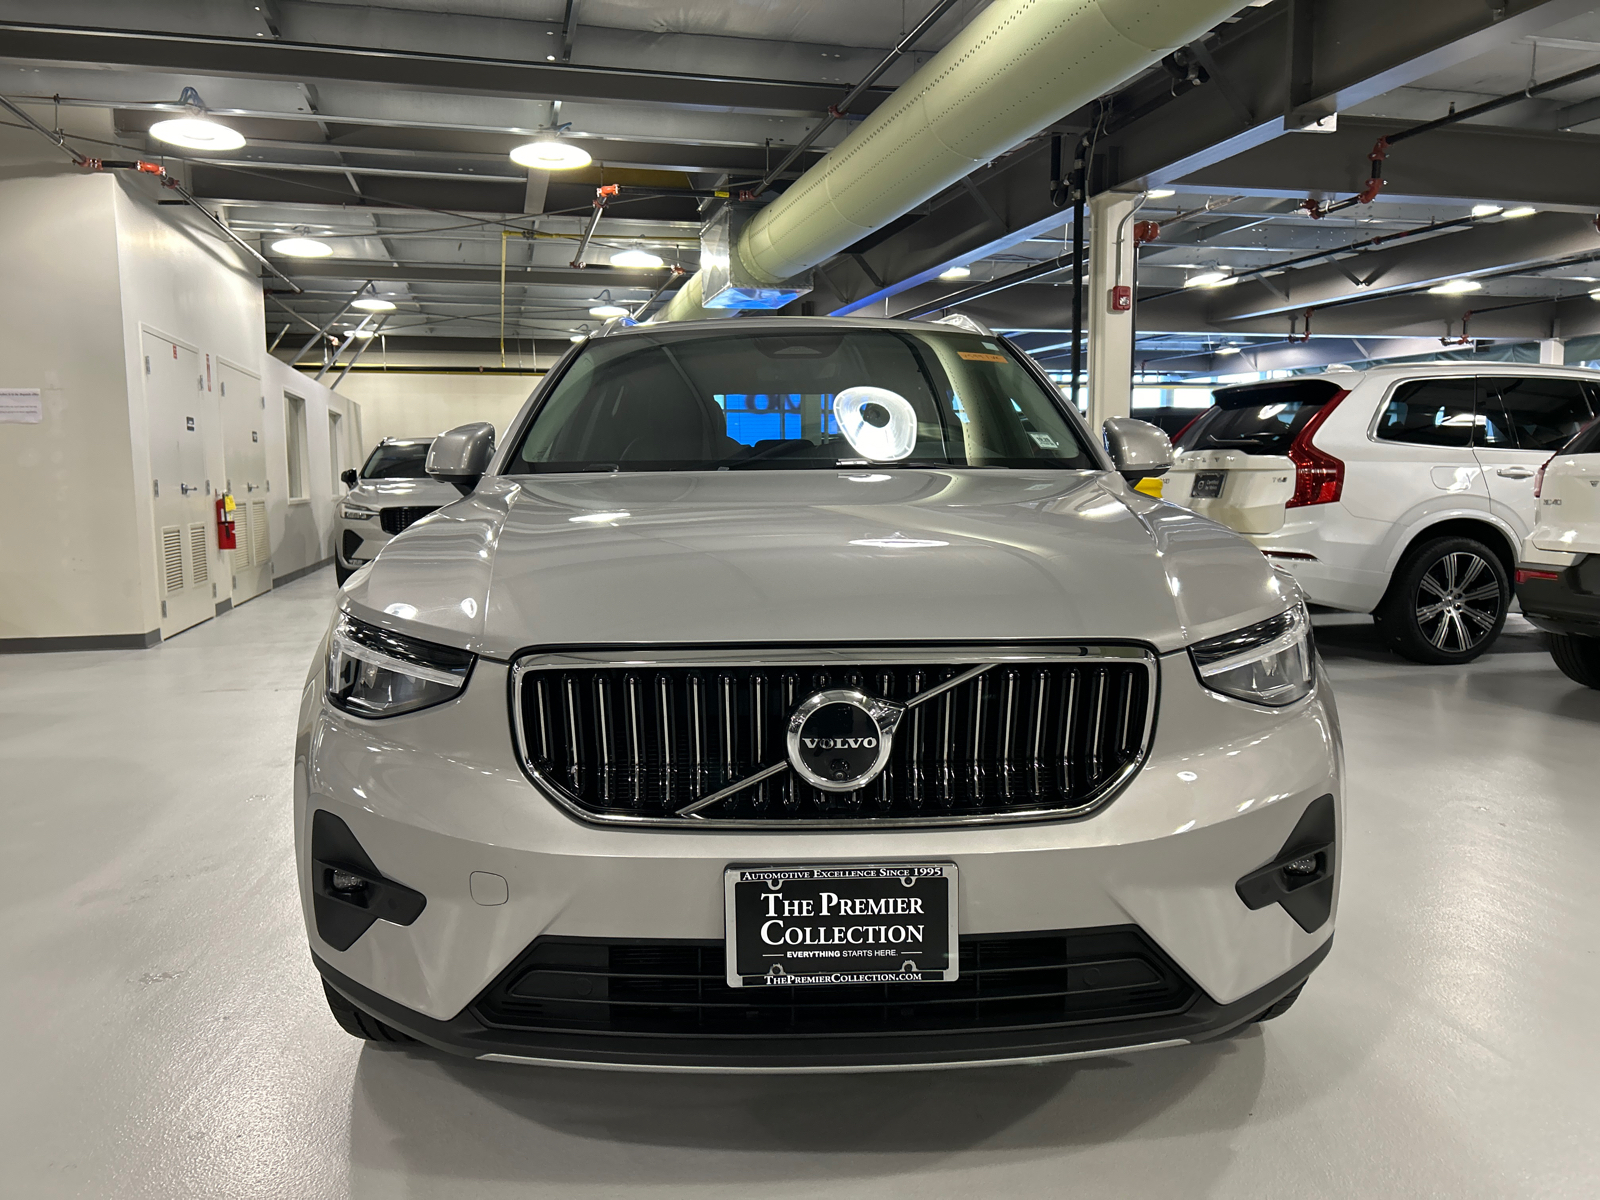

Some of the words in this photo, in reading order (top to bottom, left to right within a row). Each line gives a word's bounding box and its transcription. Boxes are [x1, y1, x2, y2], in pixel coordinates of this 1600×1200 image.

[802, 737, 877, 749] VOLVO
[913, 867, 941, 876] 1995
[874, 949, 898, 957] HERE.
